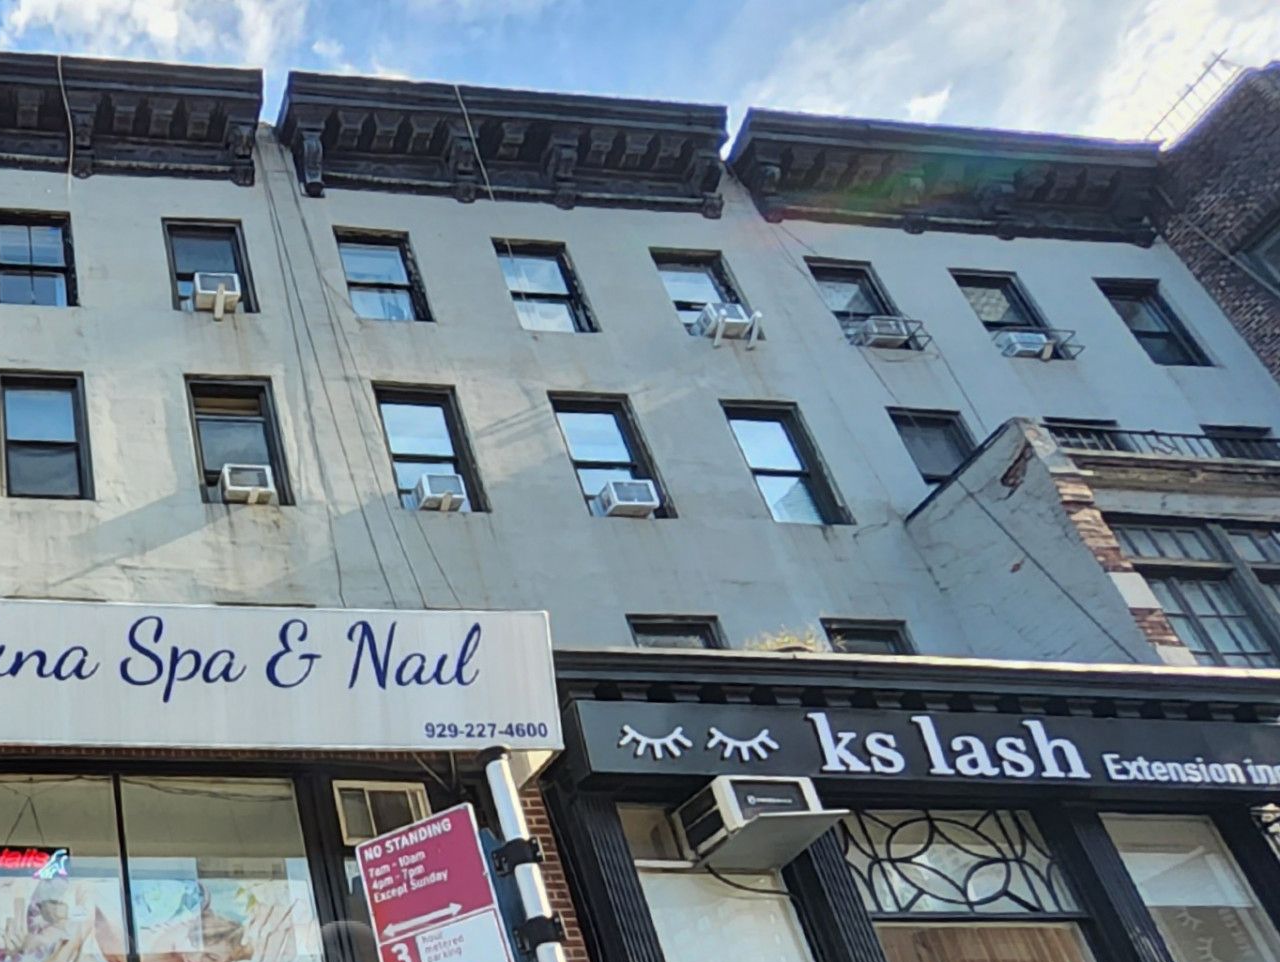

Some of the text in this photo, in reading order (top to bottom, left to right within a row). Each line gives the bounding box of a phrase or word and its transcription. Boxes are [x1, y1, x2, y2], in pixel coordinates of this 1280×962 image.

[120, 616, 247, 702] Spa
[265, 619, 321, 688] &
[347, 621, 480, 689] Nail
[424, 722, 548, 738] 929-227-4600
[806, 712, 1091, 778] ks lash
[1102, 753, 1247, 784] Extension
[363, 818, 452, 861] NO STANDING
[373, 869, 448, 903] Except Sunday
